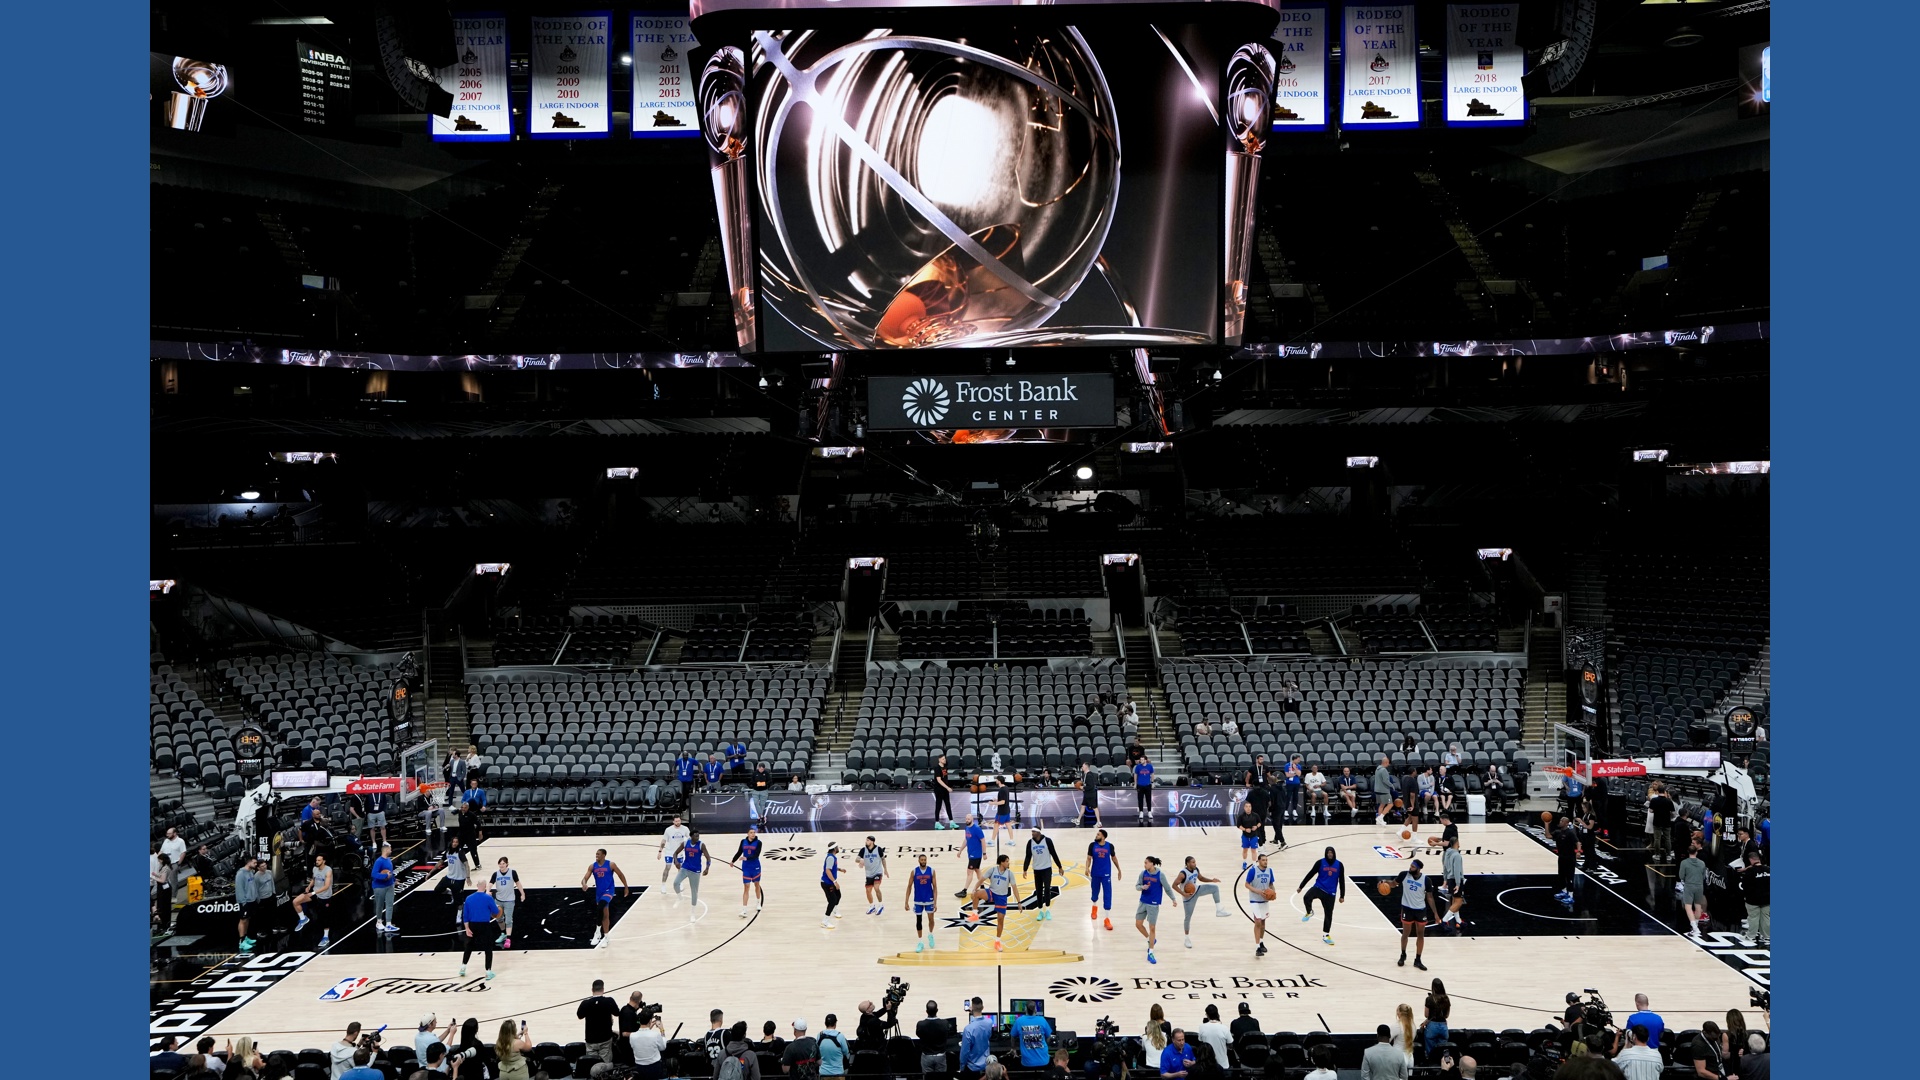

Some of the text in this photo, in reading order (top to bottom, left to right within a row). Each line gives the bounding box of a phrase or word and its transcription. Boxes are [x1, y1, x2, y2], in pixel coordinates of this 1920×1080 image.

[1282, 13, 1311, 22] DEO
[1357, 10, 1402, 20] RODEO
[454, 20, 504, 30] DEO OF
[533, 20, 606, 30] RODEO OF
[635, 20, 683, 29] RODEO
[1355, 24, 1404, 35] OF THE
[1482, 22, 1512, 32] THE
[1283, 27, 1312, 37] THE
[468, 36, 503, 45] YEAR
[534, 35, 605, 44] THE YEAR
[635, 34, 696, 43] THE YEA
[1467, 38, 1504, 48] YEAR
[1363, 40, 1396, 49] YEAR
[300, 58, 329, 67] DIVISION
[314, 51, 345, 64] NBA
[459, 68, 482, 76] 2005
[557, 66, 580, 74] 2008
[659, 65, 680, 74] 2011
[557, 78, 580, 86] 2009
[659, 77, 680, 86] 2012
[1368, 76, 1391, 86] 2017
[1474, 74, 1497, 83] 2018
[460, 80, 482, 89] 2006
[460, 92, 482, 101] 2007
[557, 90, 579, 99] 2010
[659, 89, 680, 97] 2013
[1671, 332, 1698, 346] Finals
[1284, 346, 1308, 358] Finals
[1440, 344, 1463, 355] Finals
[290, 352, 316, 363] Finals
[522, 356, 546, 368] Finals
[681, 354, 704, 366] Finals
[956, 377, 1078, 404] Frost Bank
[972, 410, 1059, 422] CENTER
[1676, 753, 1701, 766] Finals
[282, 774, 309, 786] Finals
[764, 800, 804, 816] Finals
[1177, 793, 1222, 815] Finals
[898, 845, 961, 853] Bank
[197, 901, 240, 914] coinba
[1131, 974, 1327, 990] Frost Bank
[326, 977, 492, 1002] Finals
[708, 1046, 720, 1059] 23
